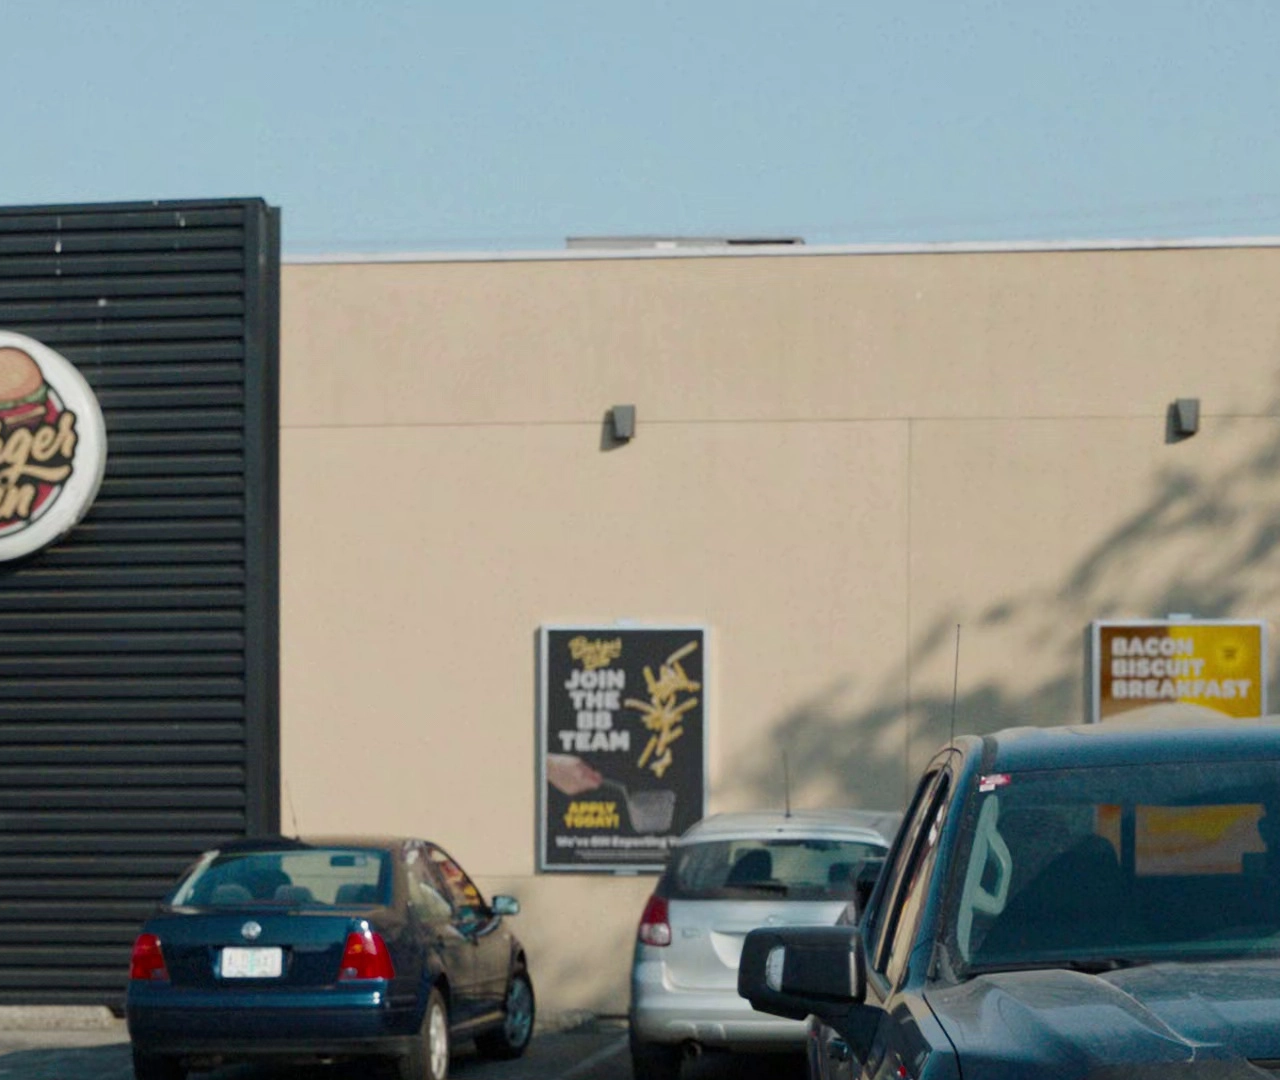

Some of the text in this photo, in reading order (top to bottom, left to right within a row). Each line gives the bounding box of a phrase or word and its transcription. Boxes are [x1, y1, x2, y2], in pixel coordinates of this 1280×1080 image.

[1111, 636, 1194, 656] BACON
[1111, 658, 1205, 677] BISCUIT
[564, 668, 626, 690] JOIN
[1111, 679, 1252, 698] BREAKFAST
[568, 690, 621, 710] THE
[558, 730, 631, 751] TEAM
